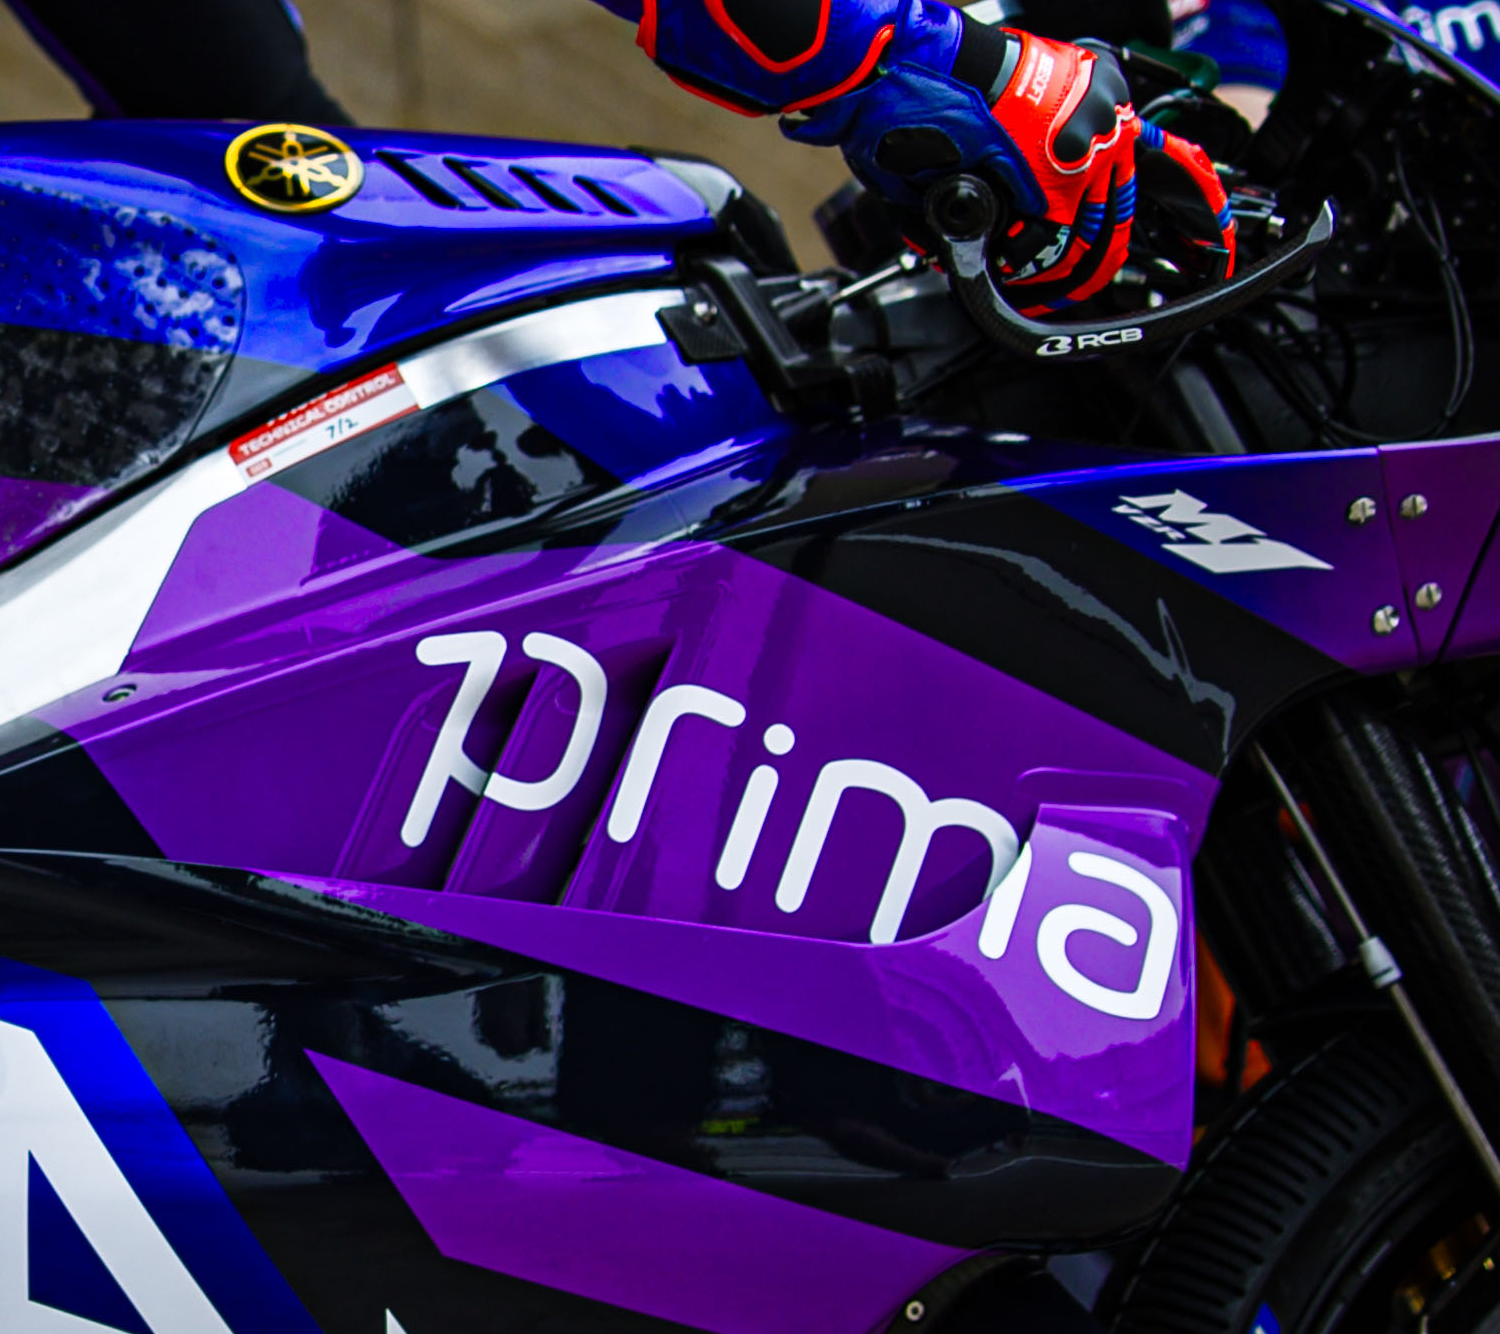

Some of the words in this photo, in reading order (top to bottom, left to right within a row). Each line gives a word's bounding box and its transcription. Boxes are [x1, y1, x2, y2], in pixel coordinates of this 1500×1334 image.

[1078, 327, 1143, 350] RCB
[239, 408, 325, 456] TECHNICAL
[324, 374, 395, 414] CONTROL
[401, 628, 1180, 1021] prima
